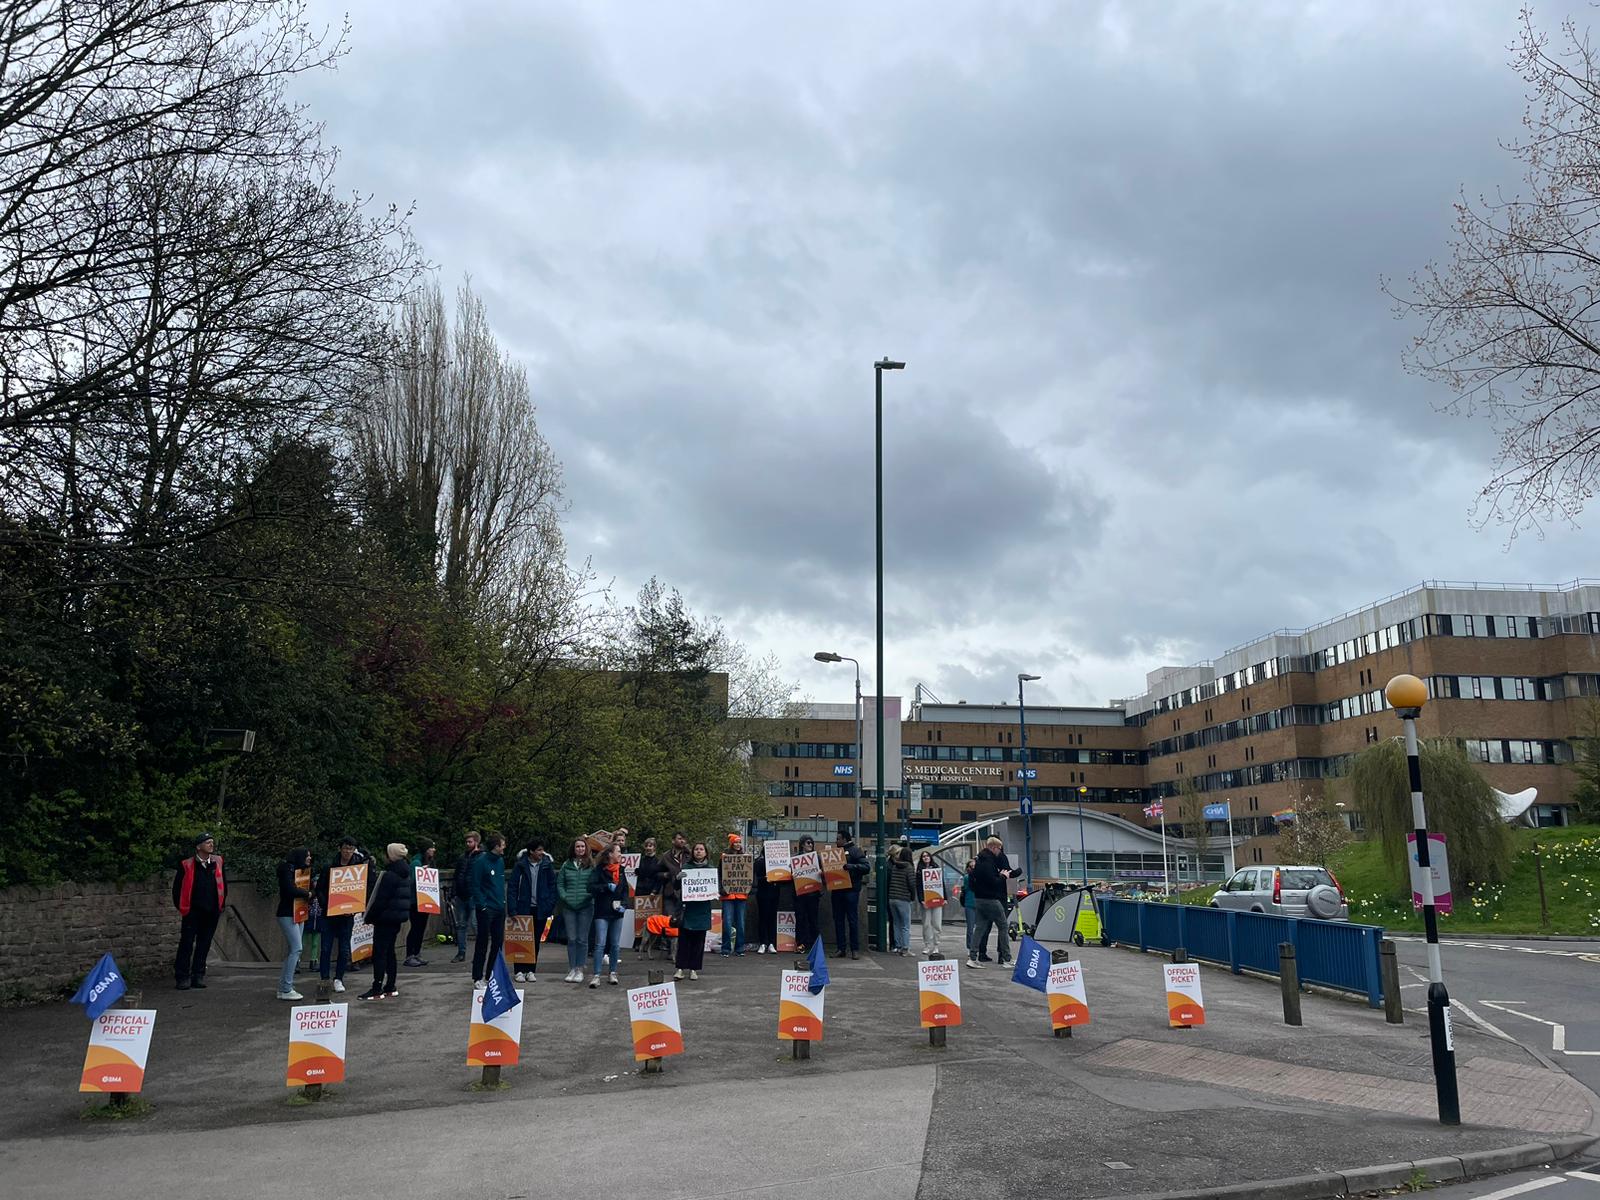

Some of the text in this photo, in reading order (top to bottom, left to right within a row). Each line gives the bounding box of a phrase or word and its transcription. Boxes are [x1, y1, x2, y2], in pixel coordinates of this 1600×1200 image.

[834, 766, 853, 774] NHS
[915, 766, 959, 775] MEDICAL
[962, 766, 1002, 776] CENTRE
[1017, 769, 1036, 778] NHS
[940, 775, 973, 783] HOSPITAL
[620, 856, 639, 869] PAY
[822, 850, 843, 864] PAY
[792, 856, 815, 870] PAY
[332, 866, 366, 883] PAY
[416, 869, 437, 884] PAY
[923, 870, 942, 881] PAY
[683, 878, 717, 886] RESUSCITATE
[331, 884, 365, 894] DOCTORS
[635, 897, 659, 910] PAY
[504, 918, 531, 931] PAY
[778, 913, 796, 925] PA
[921, 965, 956, 974] OFFICIAL
[1048, 966, 1079, 978] OFFICIAL
[1167, 968, 1198, 977] OFFICIAL
[785, 975, 809, 984] OFFIC
[926, 972, 952, 981] PICKET
[1052, 973, 1077, 985] PICKET
[1171, 975, 1195, 984] PICKET
[789, 983, 809, 992] PICK
[631, 989, 673, 1003] OFFICIAL
[637, 998, 669, 1010] PICKET
[99, 1014, 150, 1026] OFFICIAL
[295, 1010, 344, 1022] OFFICIAL
[102, 1025, 143, 1035] PICKET
[300, 1019, 337, 1030] PICKET
